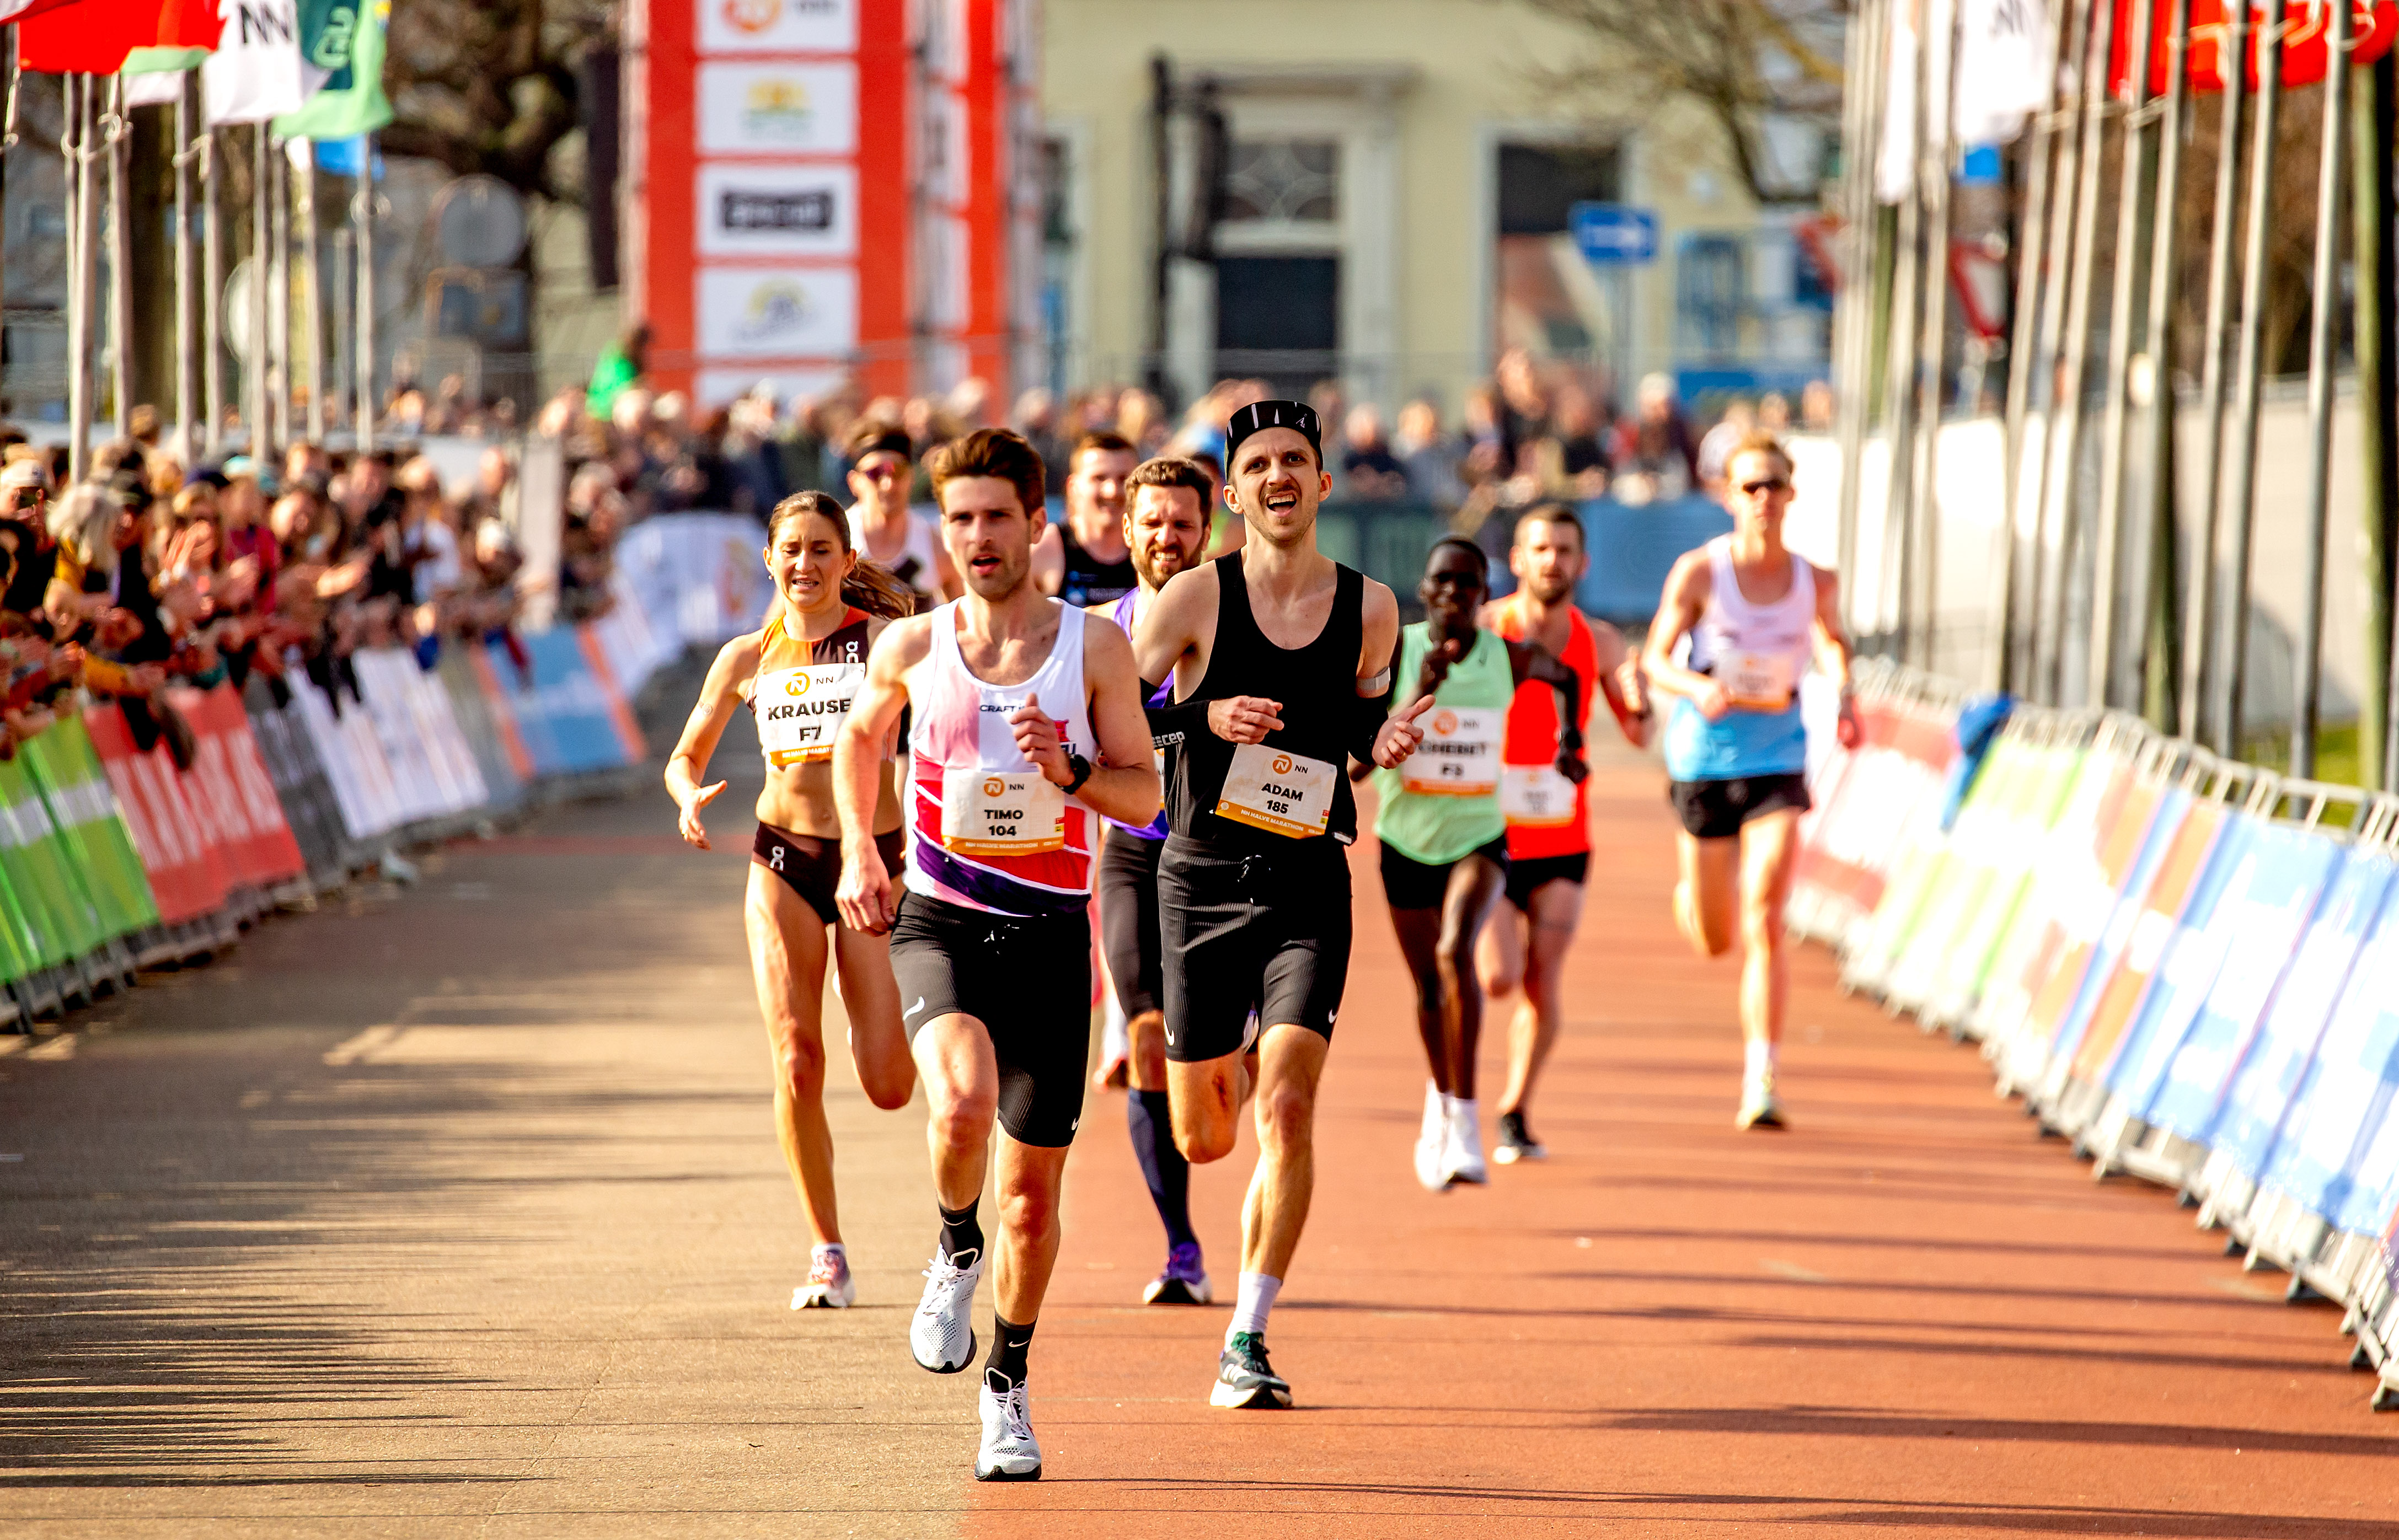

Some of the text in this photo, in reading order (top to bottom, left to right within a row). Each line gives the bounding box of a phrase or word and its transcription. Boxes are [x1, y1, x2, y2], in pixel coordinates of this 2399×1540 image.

[816, 677, 833, 685] NN
[768, 697, 851, 721] KRAUSE
[799, 725, 821, 741] F7
[1294, 764, 1308, 774] NN
[1261, 783, 1303, 801] ADAM
[1266, 800, 1289, 814] 185
[984, 809, 1024, 820] TIMO
[1250, 812, 1270, 822] HALVE
[1270, 818, 1304, 831] MARATHON
[989, 825, 1017, 836] 104
